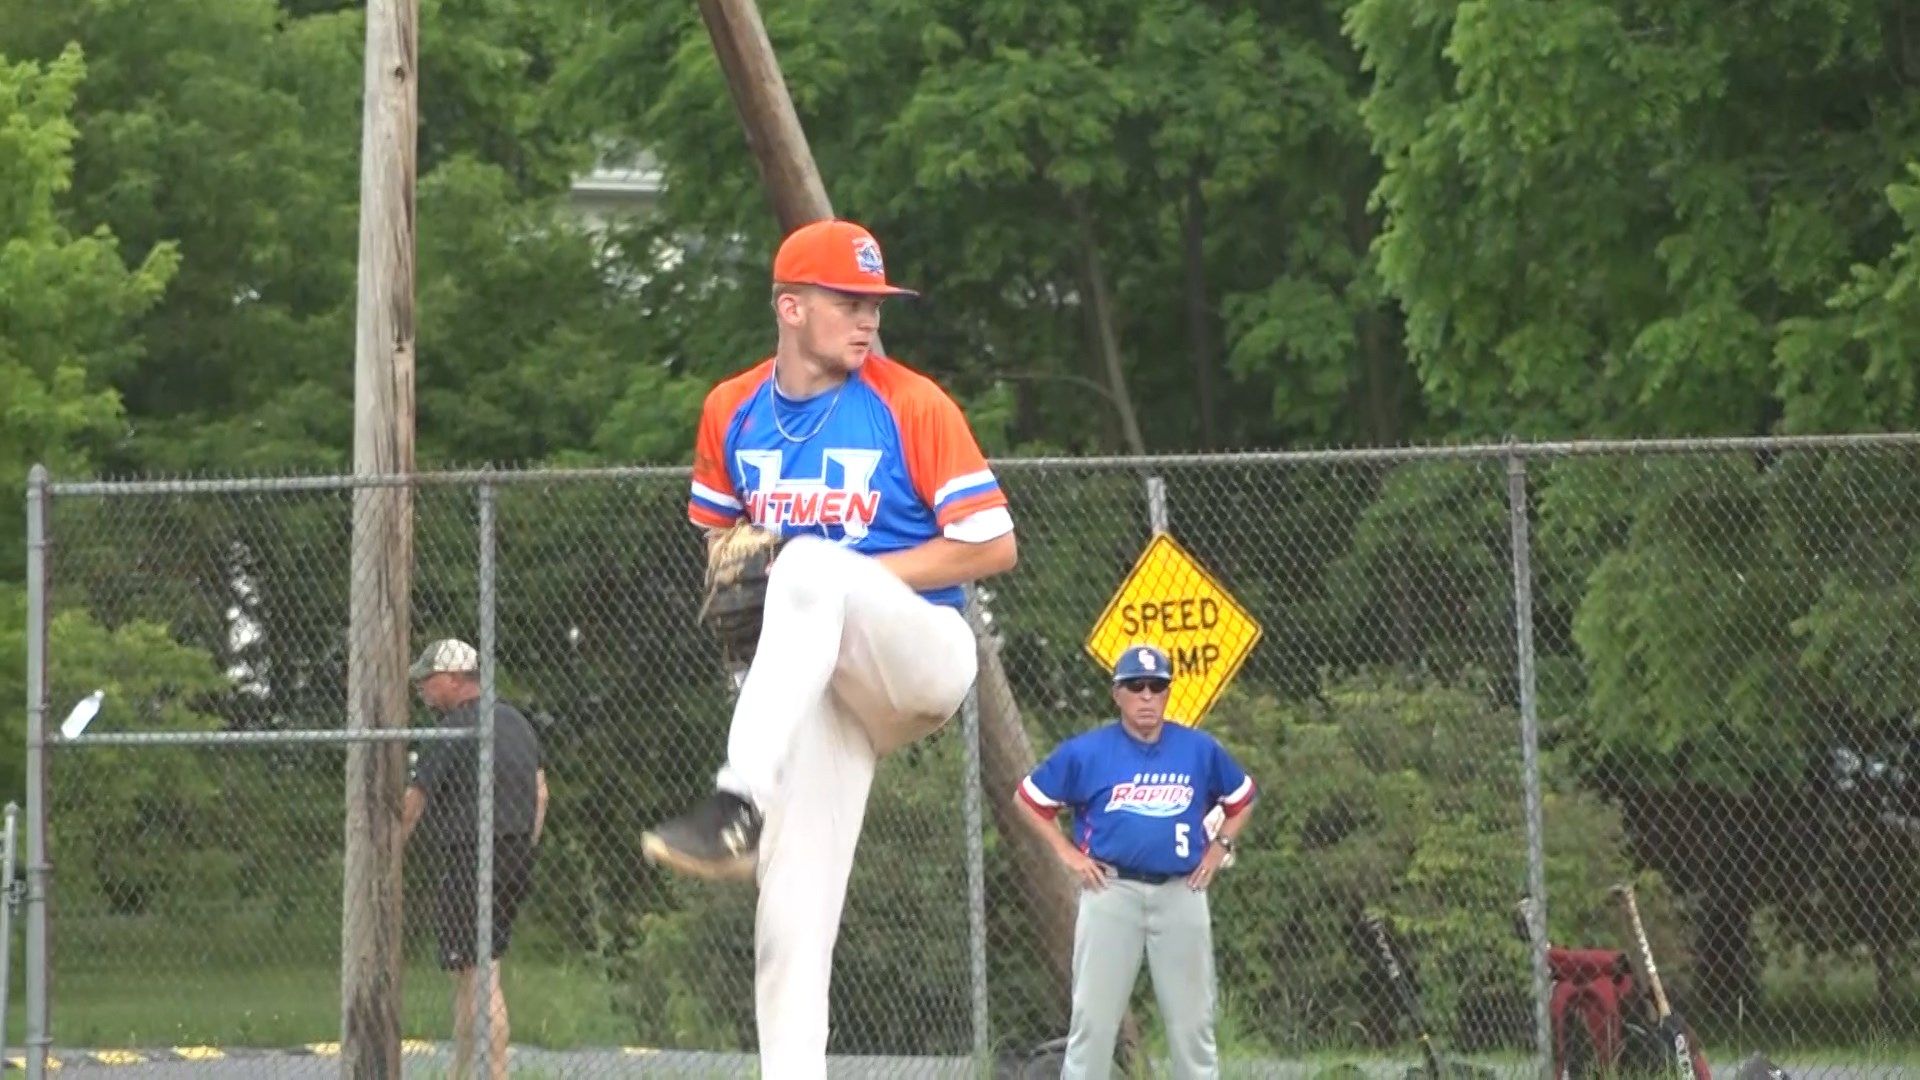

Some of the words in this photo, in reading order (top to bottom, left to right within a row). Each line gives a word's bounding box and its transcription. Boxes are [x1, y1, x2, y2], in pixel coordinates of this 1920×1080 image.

[1121, 598, 1219, 636] SPEED
[1168, 644, 1220, 678] MP
[1175, 823, 1190, 858] 5
